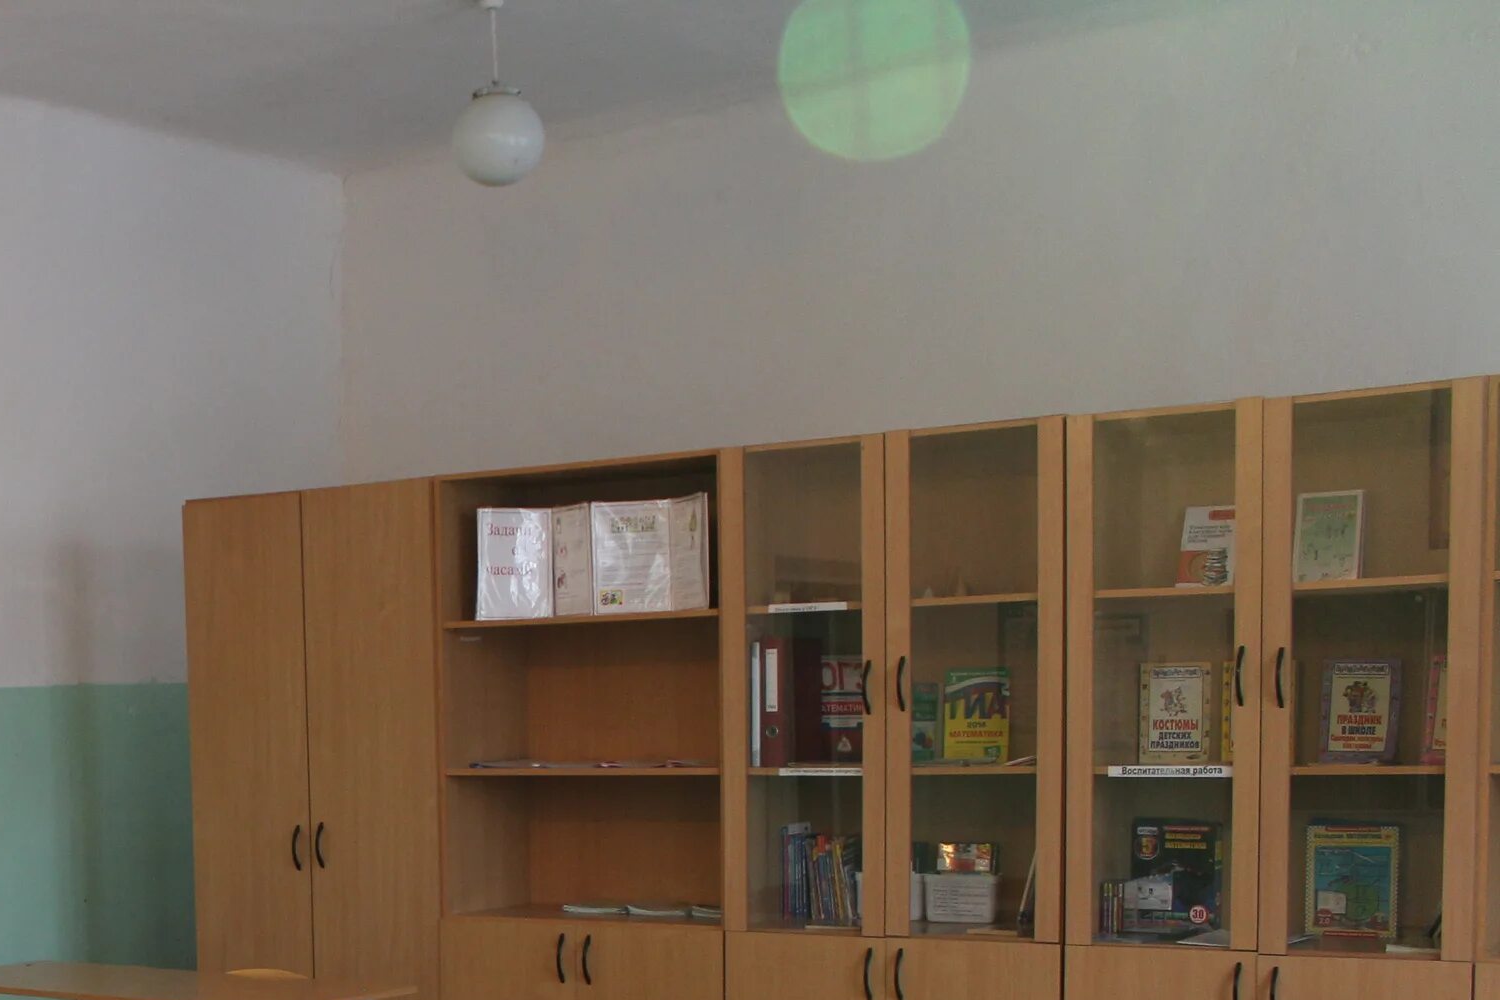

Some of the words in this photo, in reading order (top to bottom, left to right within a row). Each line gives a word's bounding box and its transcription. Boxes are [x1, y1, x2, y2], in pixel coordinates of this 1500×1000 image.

[1153, 719, 1199, 730] КОСТЮМЫ
[1336, 715, 1382, 725] ПРАЗДНИК
[950, 730, 1003, 738] МАТЕМАТИКА
[1341, 726, 1346, 735] В
[1348, 726, 1376, 735] ШКОЛЕ
[1159, 731, 1192, 741] ДЕТСКИХ
[1150, 741, 1200, 749] ПРАЗДНИКОВ
[1121, 766, 1191, 776] Воспитательная
[1192, 765, 1223, 776] работа
[1192, 907, 1205, 919] 30
